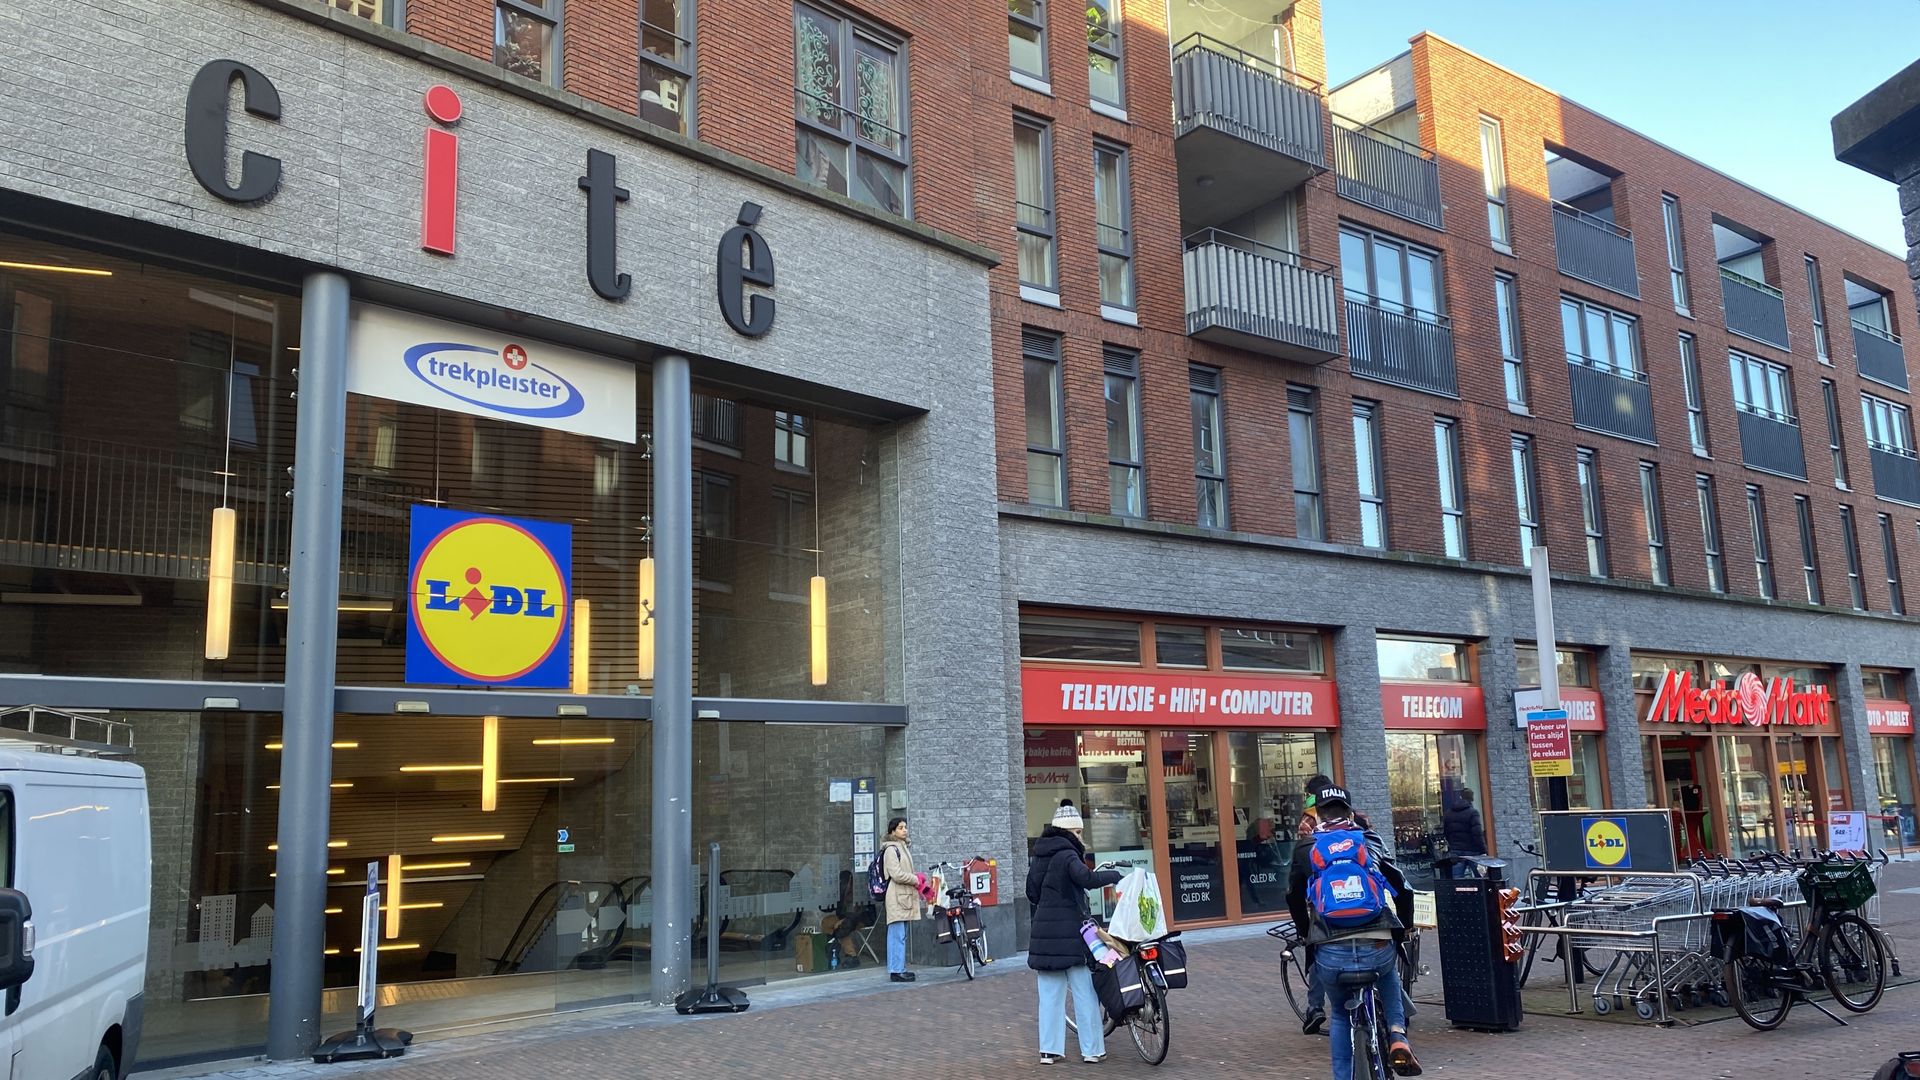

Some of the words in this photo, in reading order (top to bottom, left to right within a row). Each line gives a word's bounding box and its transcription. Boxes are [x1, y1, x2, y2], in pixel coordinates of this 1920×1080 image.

[185, 58, 776, 338] cité
[429, 357, 561, 399] trekpleister
[1061, 683, 1155, 712] TELEVISIE
[1169, 687, 1207, 713] HIFI
[1220, 689, 1313, 716] COMPUTER
[1401, 695, 1463, 719] TELECOM
[1885, 710, 1909, 727] TABLET
[1530, 723, 1555, 731] Parkeer
[1531, 732, 1546, 740] fiets
[1547, 731, 1564, 741] altijd
[1532, 750, 1541, 758] de
[1542, 748, 1566, 757] rekken!
[1322, 789, 1347, 799] ITALIA
[1249, 874, 1267, 884] QLED
[1268, 873, 1277, 882] 8K
[1180, 881, 1210, 890] kijkervaring
[1181, 893, 1200, 903] QLED
[1201, 892, 1211, 902] 8K
